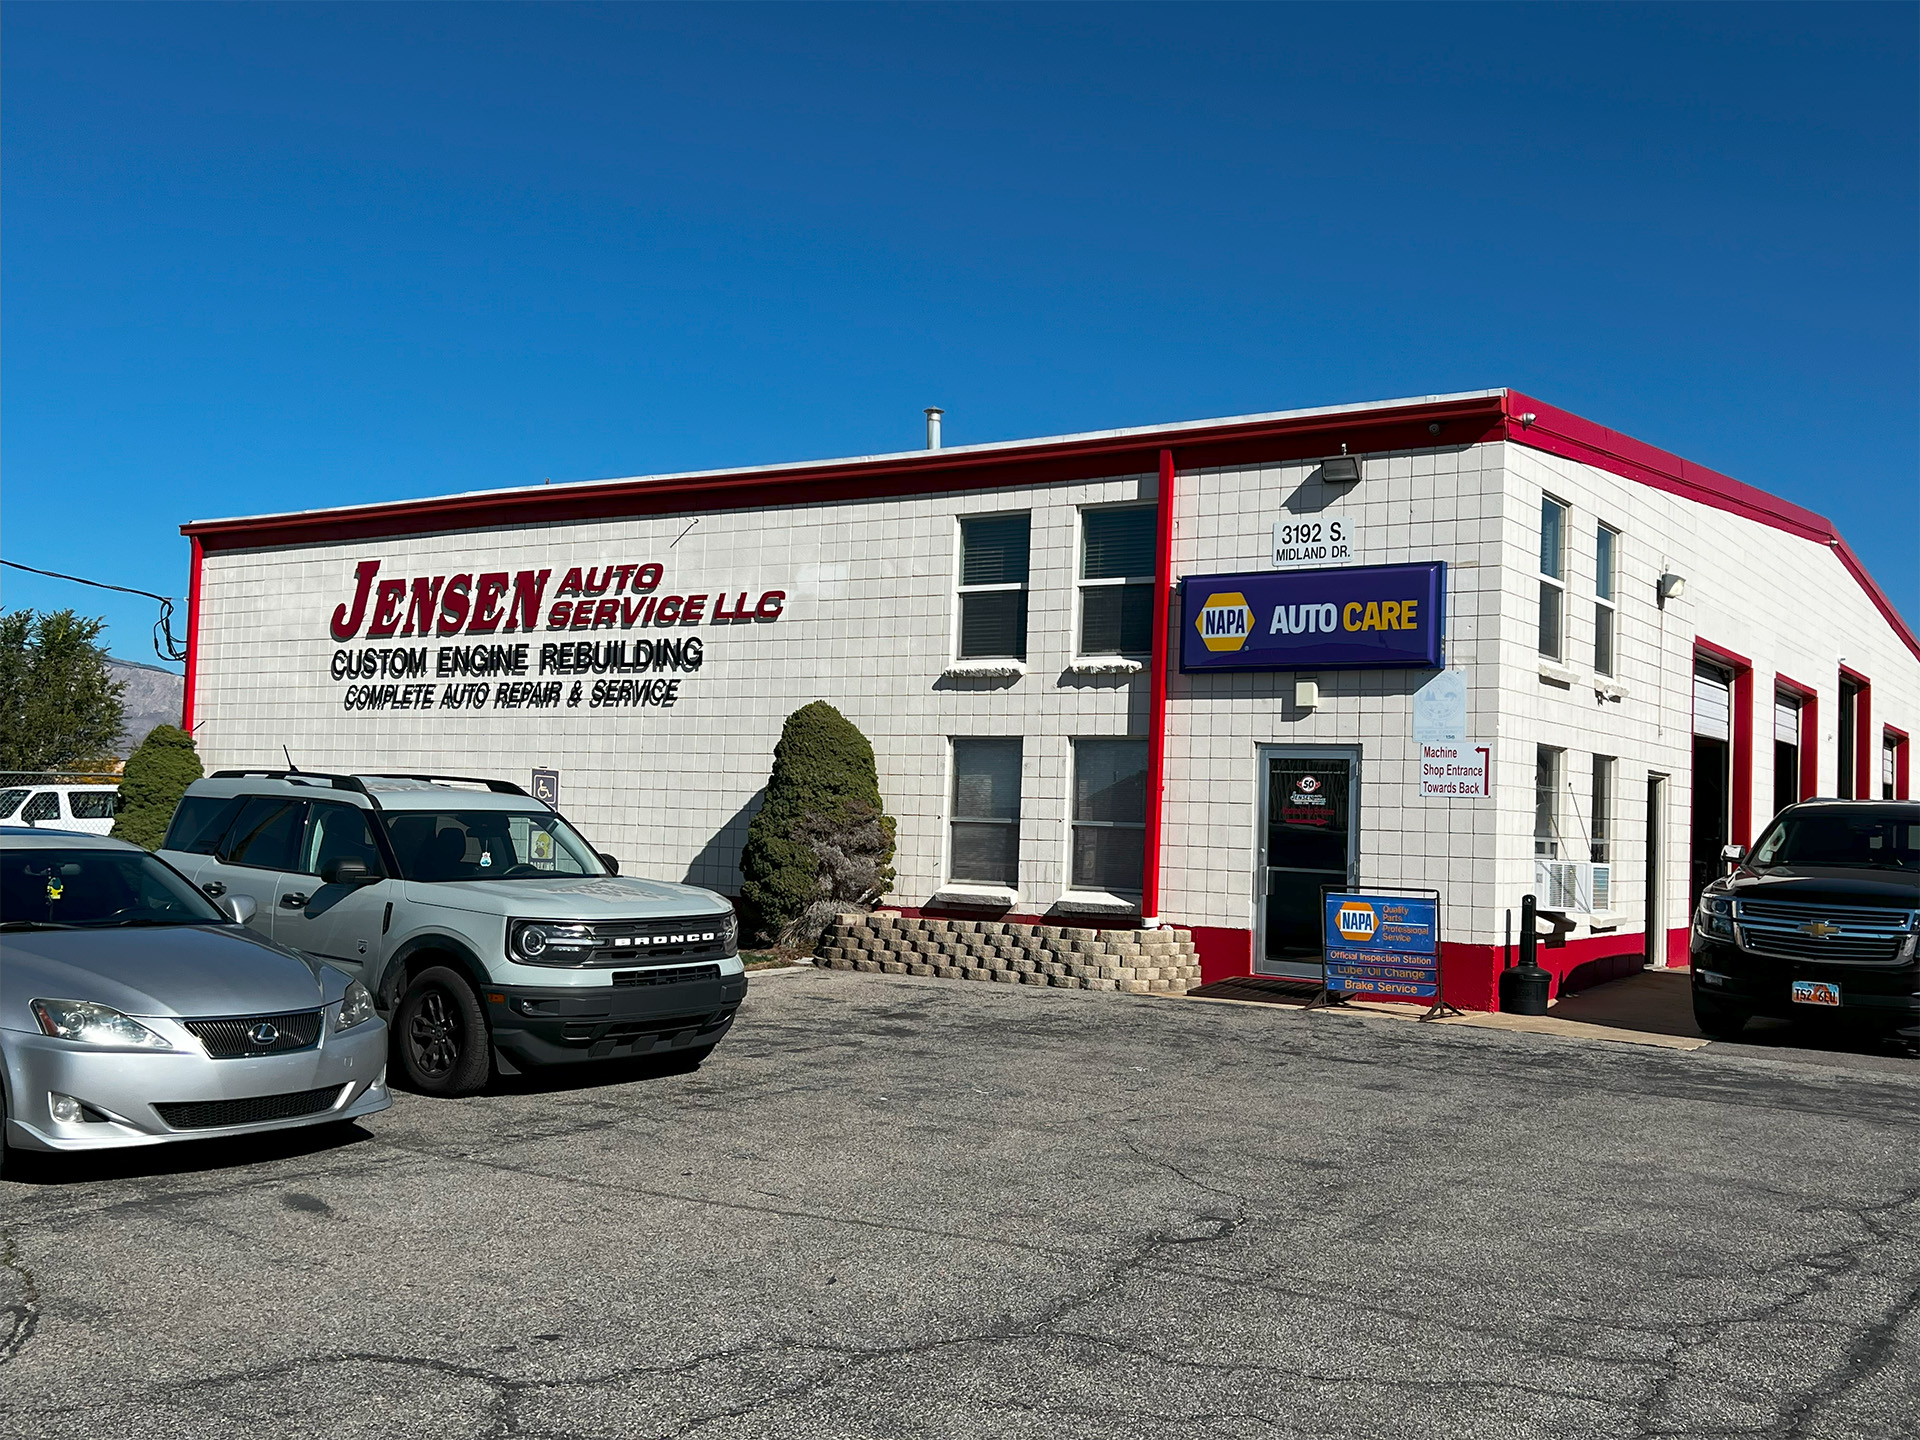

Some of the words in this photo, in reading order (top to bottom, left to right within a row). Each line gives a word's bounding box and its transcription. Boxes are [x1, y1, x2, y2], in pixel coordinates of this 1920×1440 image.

[1282, 523, 1321, 544] 3192
[1330, 522, 1346, 541] S.
[1276, 546, 1327, 561] MIDLAND
[1332, 545, 1351, 558] DR.
[555, 563, 664, 597] AUTO
[331, 560, 552, 642] JENSEN
[547, 594, 708, 630] SERVICE
[711, 591, 786, 625] LLC
[1205, 609, 1246, 635] NAPA
[1269, 603, 1338, 634] AUTO
[1343, 600, 1418, 632] CARE
[331, 647, 427, 680] CUSTOM
[437, 643, 529, 678] ENGINE
[539, 637, 703, 675] REBUILDING
[344, 684, 436, 711] COMPLETE
[439, 682, 490, 709] AUTO
[494, 681, 563, 709] REPAIR
[567, 680, 583, 708] &
[589, 679, 681, 708] SERVICE
[1423, 746, 1458, 759] Machine
[1423, 763, 1445, 778] Shop
[1446, 764, 1483, 777] Entrance
[1302, 780, 1315, 789] 50
[1423, 781, 1457, 793] Towards
[1459, 782, 1480, 794] Back
[1383, 905, 1409, 916] Quality
[1383, 914, 1403, 922] Parts
[1342, 912, 1373, 931] NAPA
[1383, 925, 1429, 935] Professional
[1383, 933, 1411, 942] Service
[615, 932, 715, 947] BRONCO
[1330, 950, 1358, 960] Official
[1360, 952, 1400, 963] Inspection
[1402, 955, 1432, 965] Station
[1384, 968, 1426, 979] Change
[1344, 980, 1374, 991] Brake
[1377, 983, 1418, 994] Service
